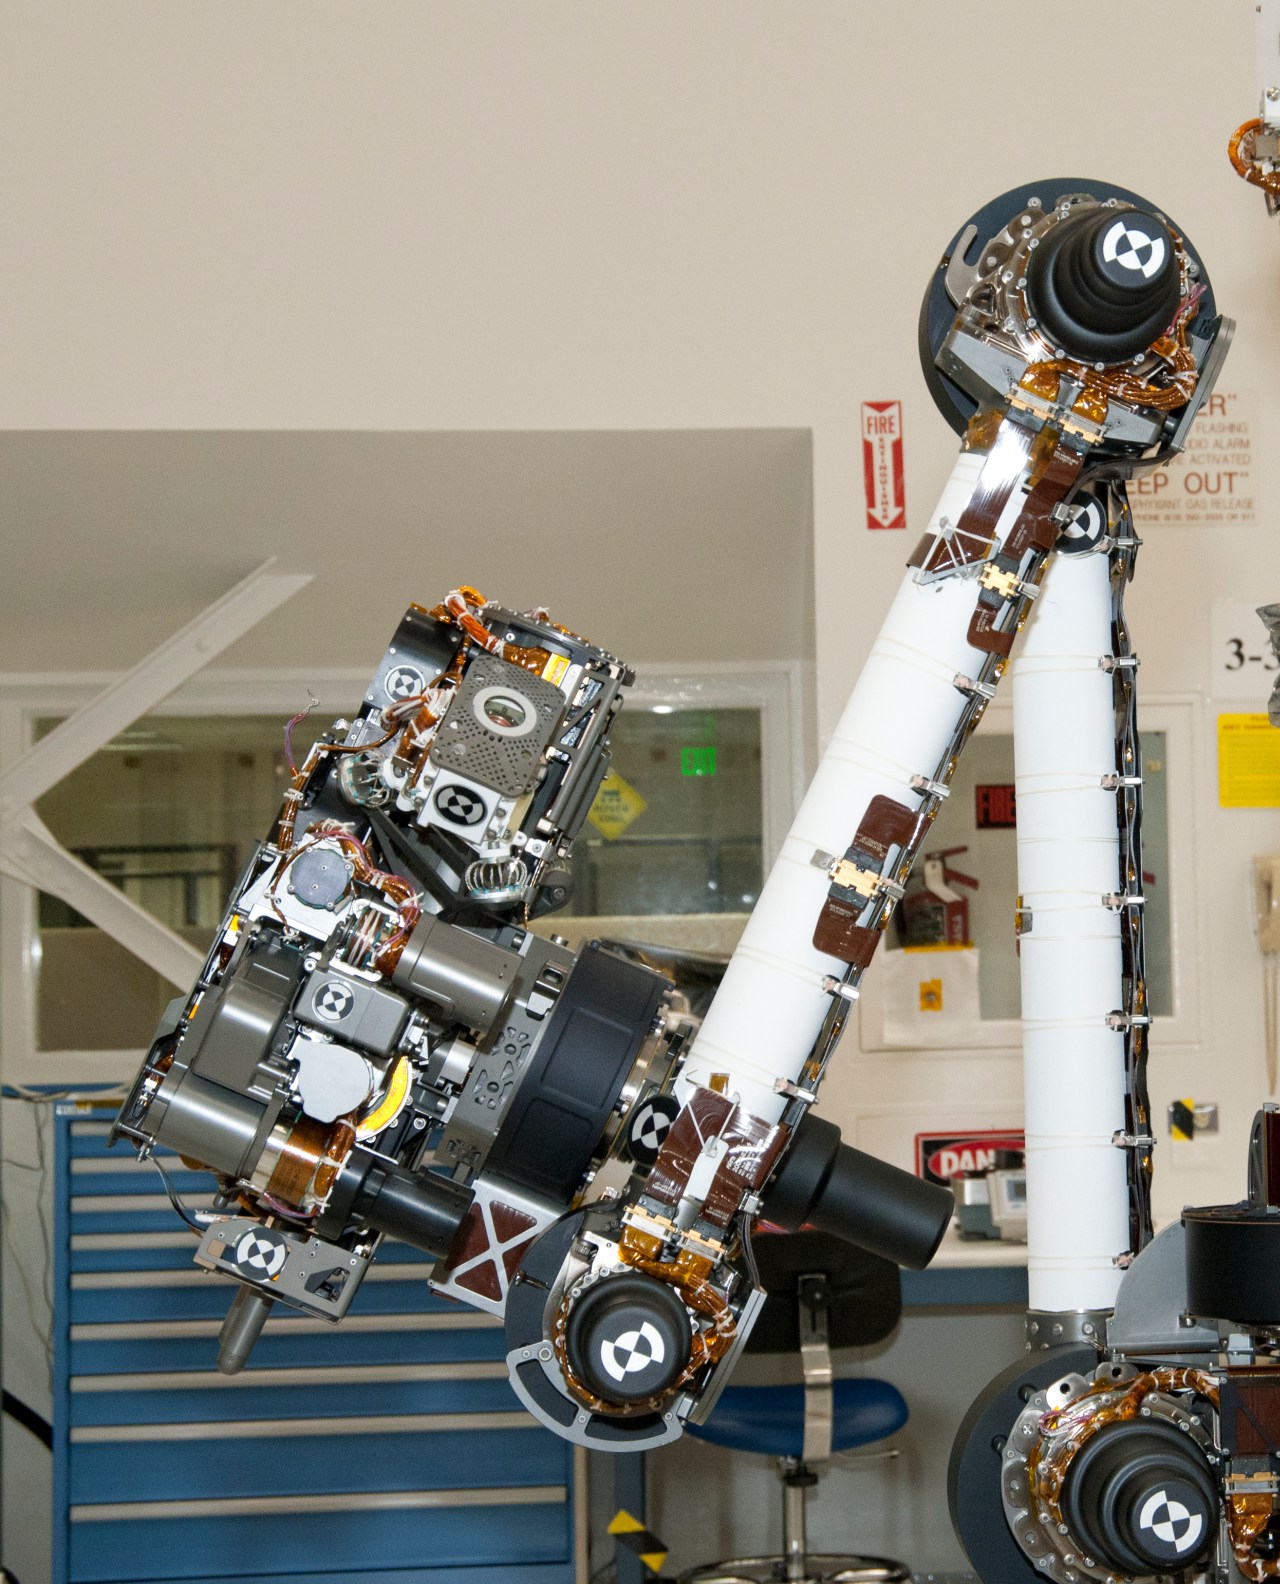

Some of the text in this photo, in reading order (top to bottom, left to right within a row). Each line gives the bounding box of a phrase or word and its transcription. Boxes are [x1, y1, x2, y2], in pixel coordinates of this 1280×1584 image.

[1197, 394, 1238, 416] R"
[867, 415, 895, 434] FIRE
[1196, 422, 1247, 433] FLASHING
[1213, 439, 1250, 449] ALARM
[1190, 453, 1252, 465] ACTIVATED
[878, 437, 889, 520] EXTINGUISHER
[1184, 472, 1249, 494] OUT"
[940, 1147, 997, 1178] DAN
